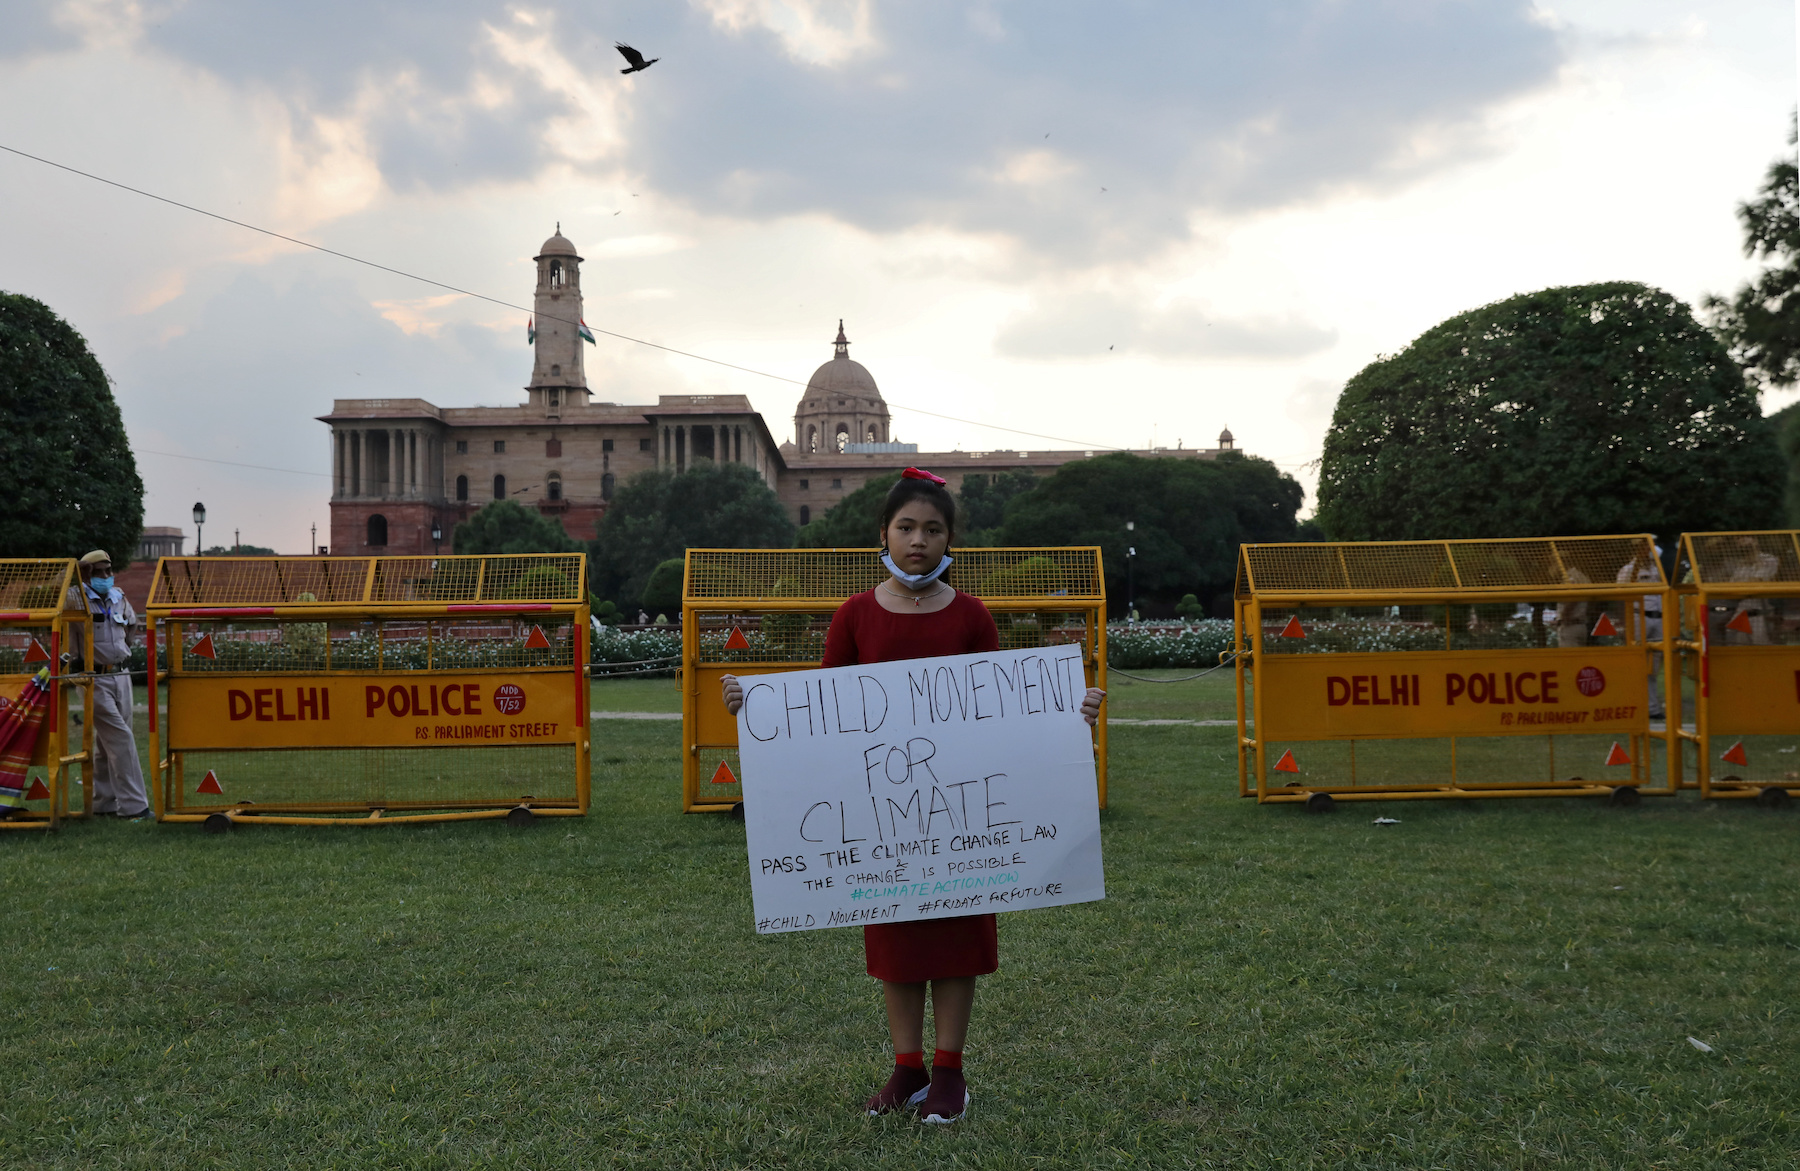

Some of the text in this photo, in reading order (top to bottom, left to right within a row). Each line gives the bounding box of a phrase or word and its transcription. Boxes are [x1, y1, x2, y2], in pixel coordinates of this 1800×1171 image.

[228, 684, 482, 721] DELHI POLICE
[500, 697, 520, 714] 1/52
[501, 686, 519, 695] NDD
[745, 655, 1081, 741] CHILD MOVEMENT
[1327, 671, 1559, 706] DELHI POLICE
[434, 725, 506, 739] PARLIAMENT
[509, 723, 558, 738] STREET
[1517, 711, 1590, 725] PARLIAMENT
[1593, 706, 1637, 722] STREET
[864, 737, 939, 794] FOR
[800, 773, 1023, 844] CLIMATE
[761, 824, 1057, 875] PASS THE CLIMATE CHANGE LAW
[803, 852, 1026, 891] THE CHANGE IS POSSIBLE
[758, 914, 816, 932] #CHILD
[918, 895, 983, 914] #FRIDAYS
